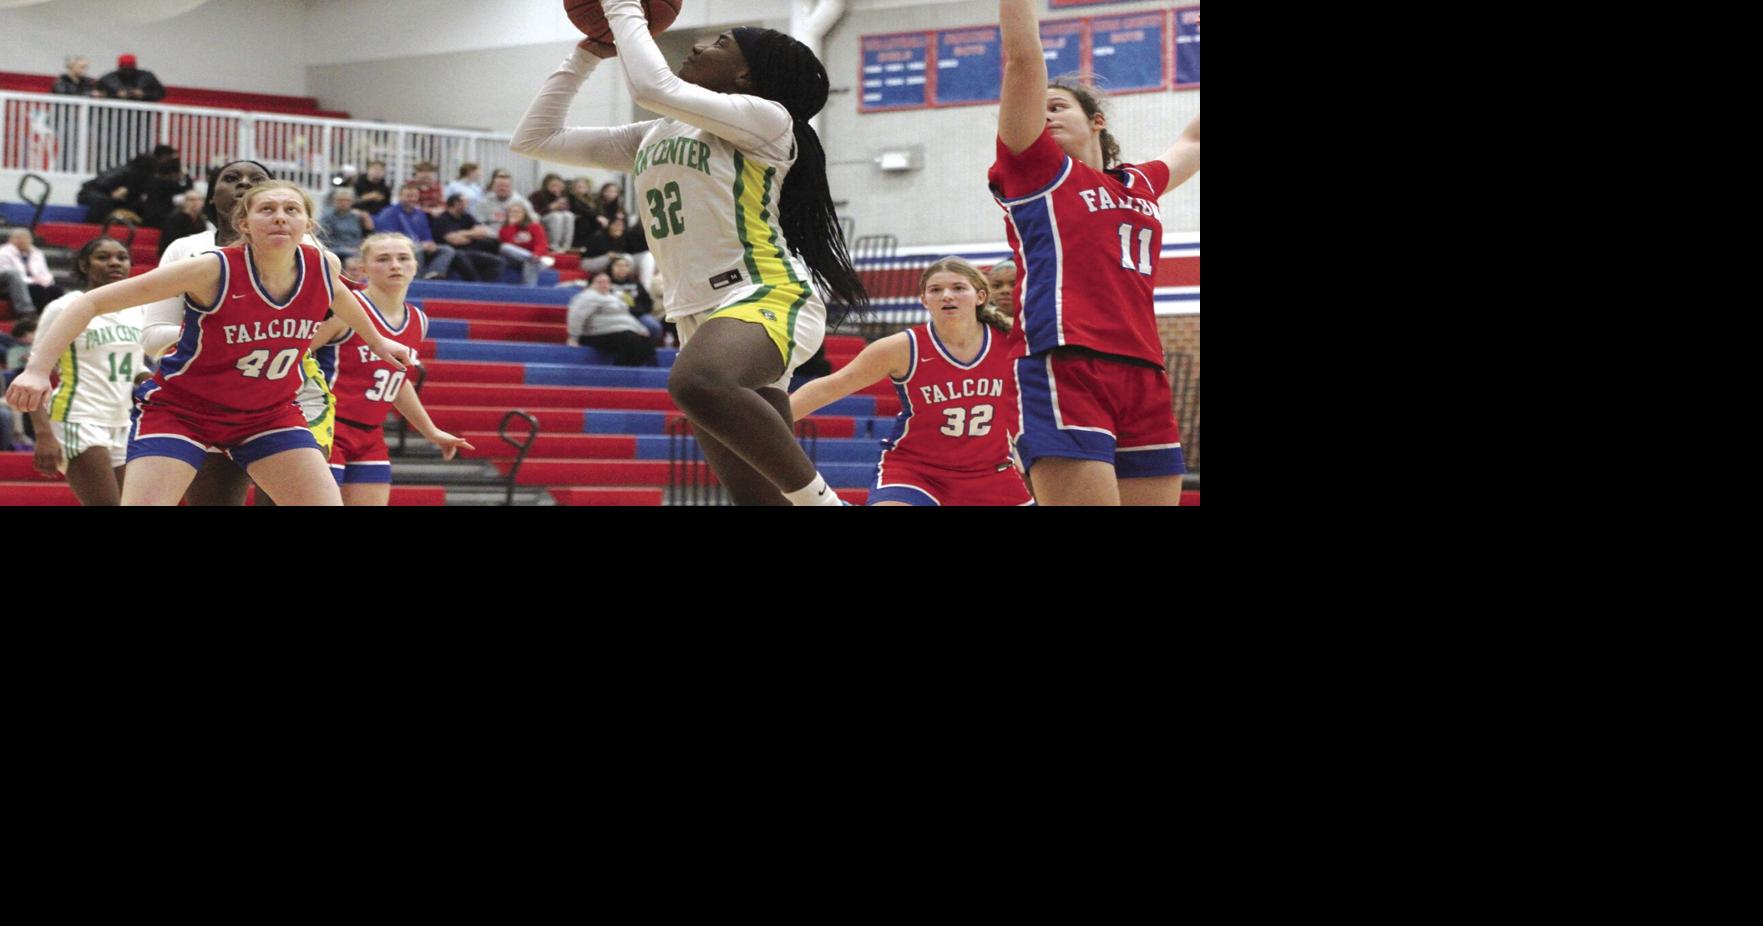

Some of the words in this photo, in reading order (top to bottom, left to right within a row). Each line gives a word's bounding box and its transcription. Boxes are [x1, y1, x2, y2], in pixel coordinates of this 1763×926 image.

[651, 136, 711, 175] CENTER
[646, 181, 685, 239] 32
[1118, 223, 1153, 275] 11
[108, 352, 132, 382] 14
[235, 347, 299, 380] 40
[365, 368, 406, 402] 30
[919, 378, 1003, 404] FALCON
[940, 403, 994, 437] 32
